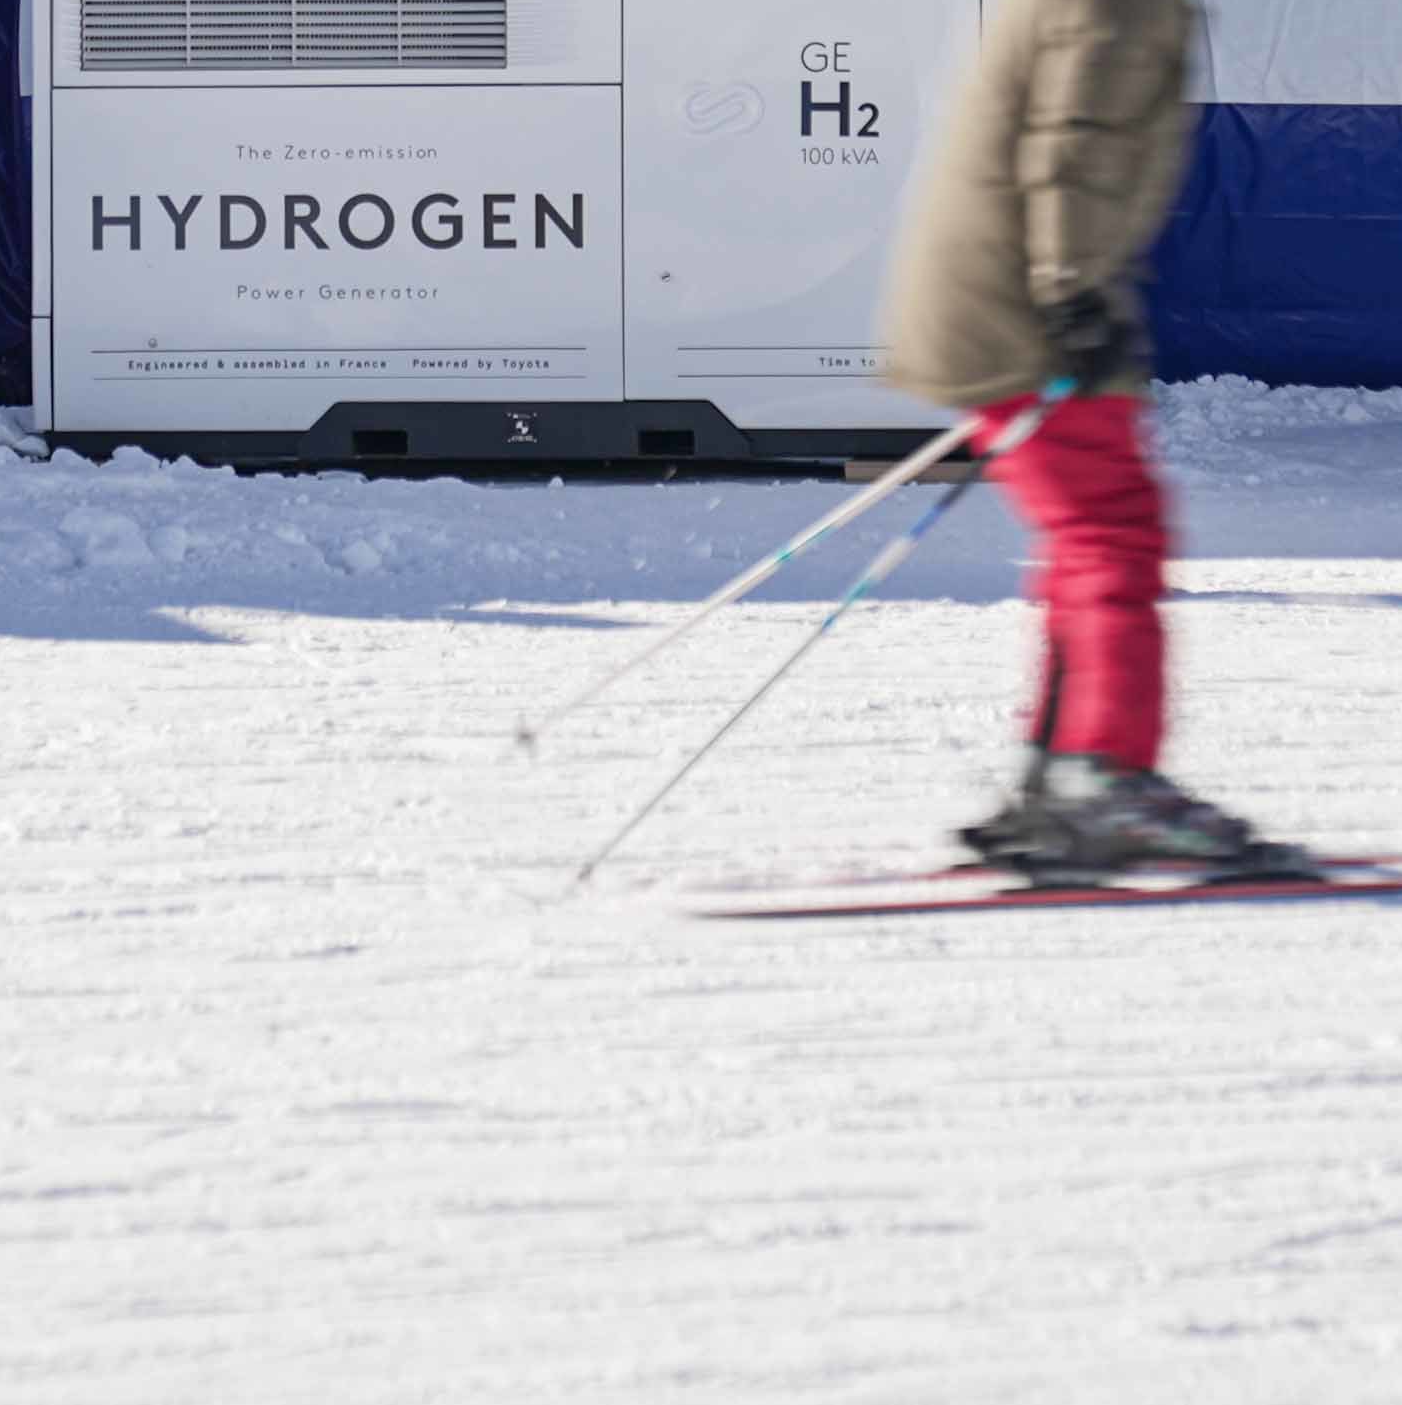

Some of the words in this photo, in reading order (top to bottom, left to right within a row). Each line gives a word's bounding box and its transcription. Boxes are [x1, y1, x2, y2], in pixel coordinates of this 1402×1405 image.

[801, 42, 852, 72] GE
[236, 145, 273, 160] The
[284, 145, 438, 161] Zero-emission
[800, 148, 835, 165] 100
[841, 147, 880, 165] kVA
[92, 193, 584, 251] HYDROGEN
[237, 284, 305, 300] Power
[318, 283, 439, 300] Generator
[128, 359, 208, 372] Engineered
[233, 359, 306, 369] assembled
[316, 359, 330, 369] in
[339, 358, 387, 369] France
[413, 358, 468, 369] Powered
[477, 359, 492, 370] by
[502, 358, 550, 370] Toyota
